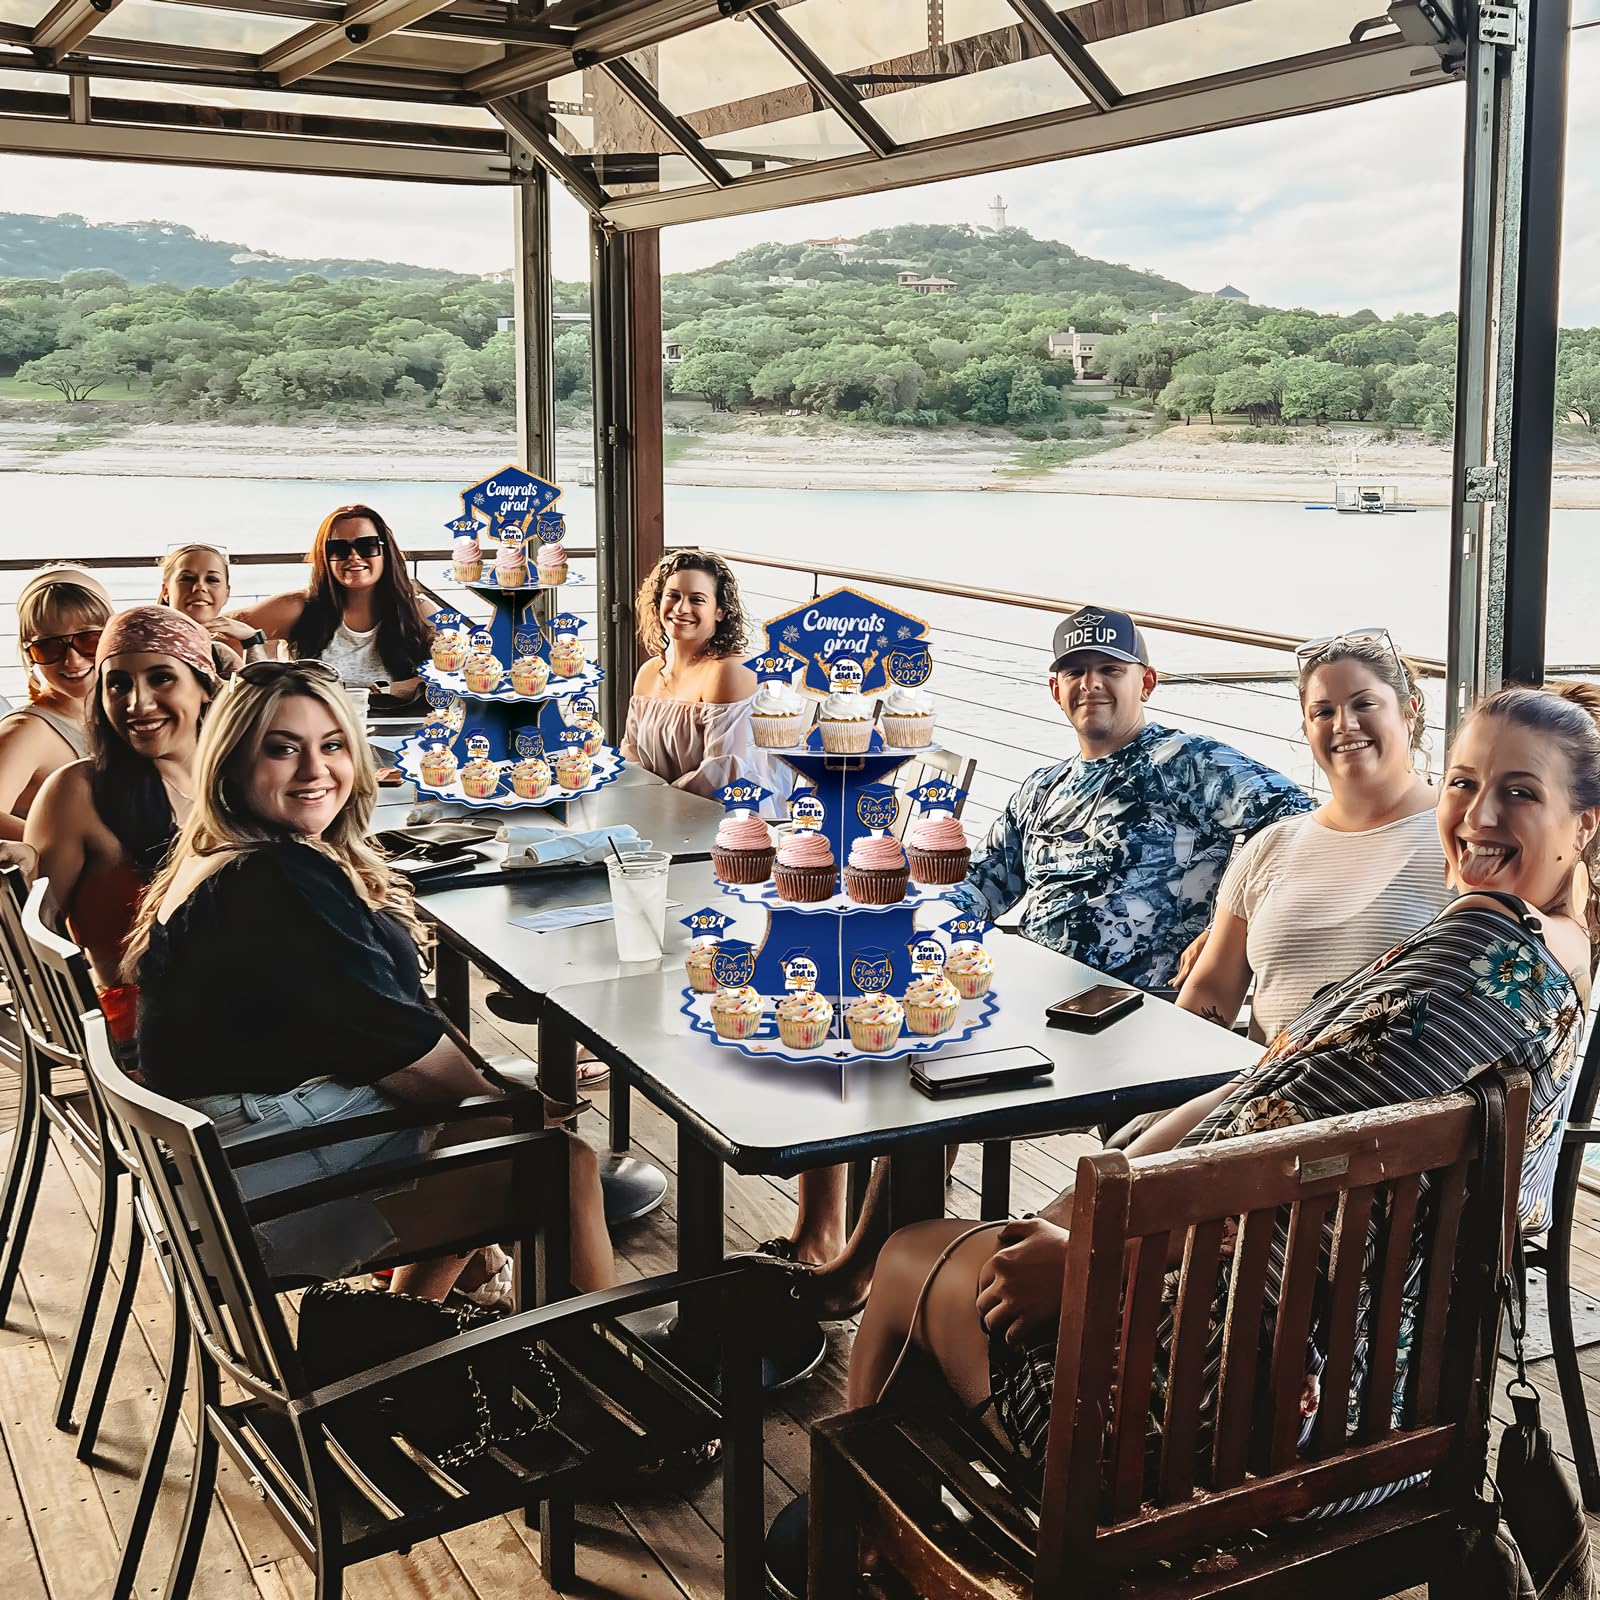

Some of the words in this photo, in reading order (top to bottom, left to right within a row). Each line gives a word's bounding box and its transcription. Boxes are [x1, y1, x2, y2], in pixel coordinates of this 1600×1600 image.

[486, 481, 538, 500] Congrats
[500, 497, 529, 515] grad
[541, 532, 561, 540] 2024
[802, 609, 886, 637] Congrats
[1063, 627, 1093, 649] TIDE
[1095, 627, 1117, 643] UP
[519, 644, 538, 652] 2024
[835, 663, 854, 671] You
[891, 656, 914, 670] Class
[917, 657, 925, 670] of
[834, 672, 851, 680] did
[852, 672, 861, 680] it
[895, 669, 925, 681] 2024
[430, 697, 451, 705] 2024
[520, 747, 539, 755] 2024
[797, 801, 815, 809] You
[860, 800, 883, 813] Class
[884, 801, 892, 813] of
[796, 809, 813, 817] did
[814, 809, 822, 817] it
[864, 812, 892, 824] 2024
[917, 945, 935, 953] You
[916, 953, 933, 961] did
[933, 953, 942, 961] it
[714, 958, 738, 970] Class
[740, 959, 749, 971] of
[790, 962, 808, 970] You
[789, 970, 806, 978] did
[806, 970, 816, 978] it
[854, 963, 877, 977] Class
[719, 970, 748, 982] 2024
[858, 976, 886, 988] 2024
